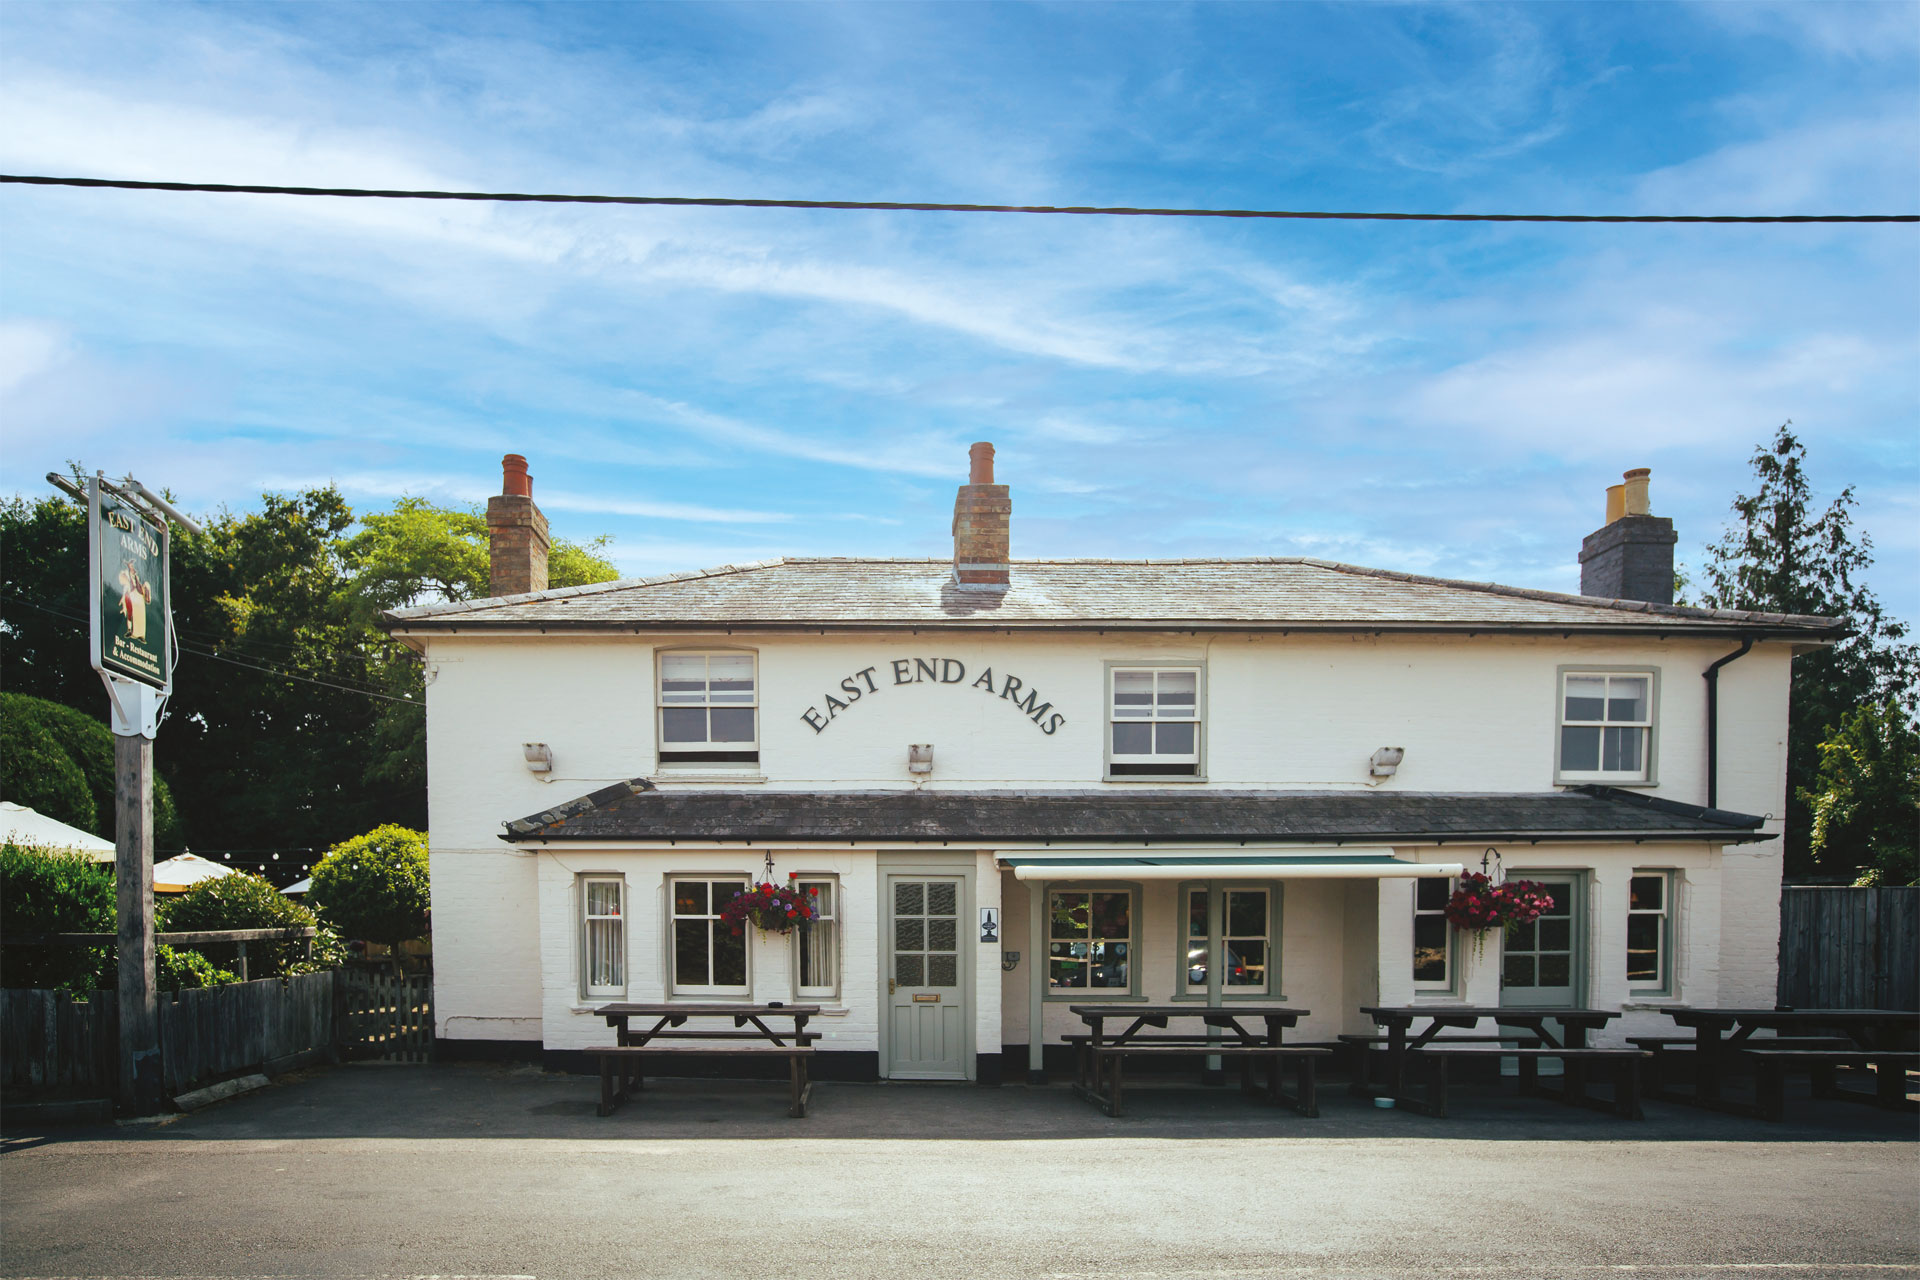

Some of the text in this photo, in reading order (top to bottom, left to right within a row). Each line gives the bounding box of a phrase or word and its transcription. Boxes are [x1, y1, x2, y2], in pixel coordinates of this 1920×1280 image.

[108, 511, 158, 557] EAST END
[120, 534, 147, 560] ARMS
[112, 646, 160, 675] & Accommodation
[115, 635, 126, 648] Bar
[130, 641, 157, 663] Restaurant
[800, 657, 1066, 736] EAST END ARMS
